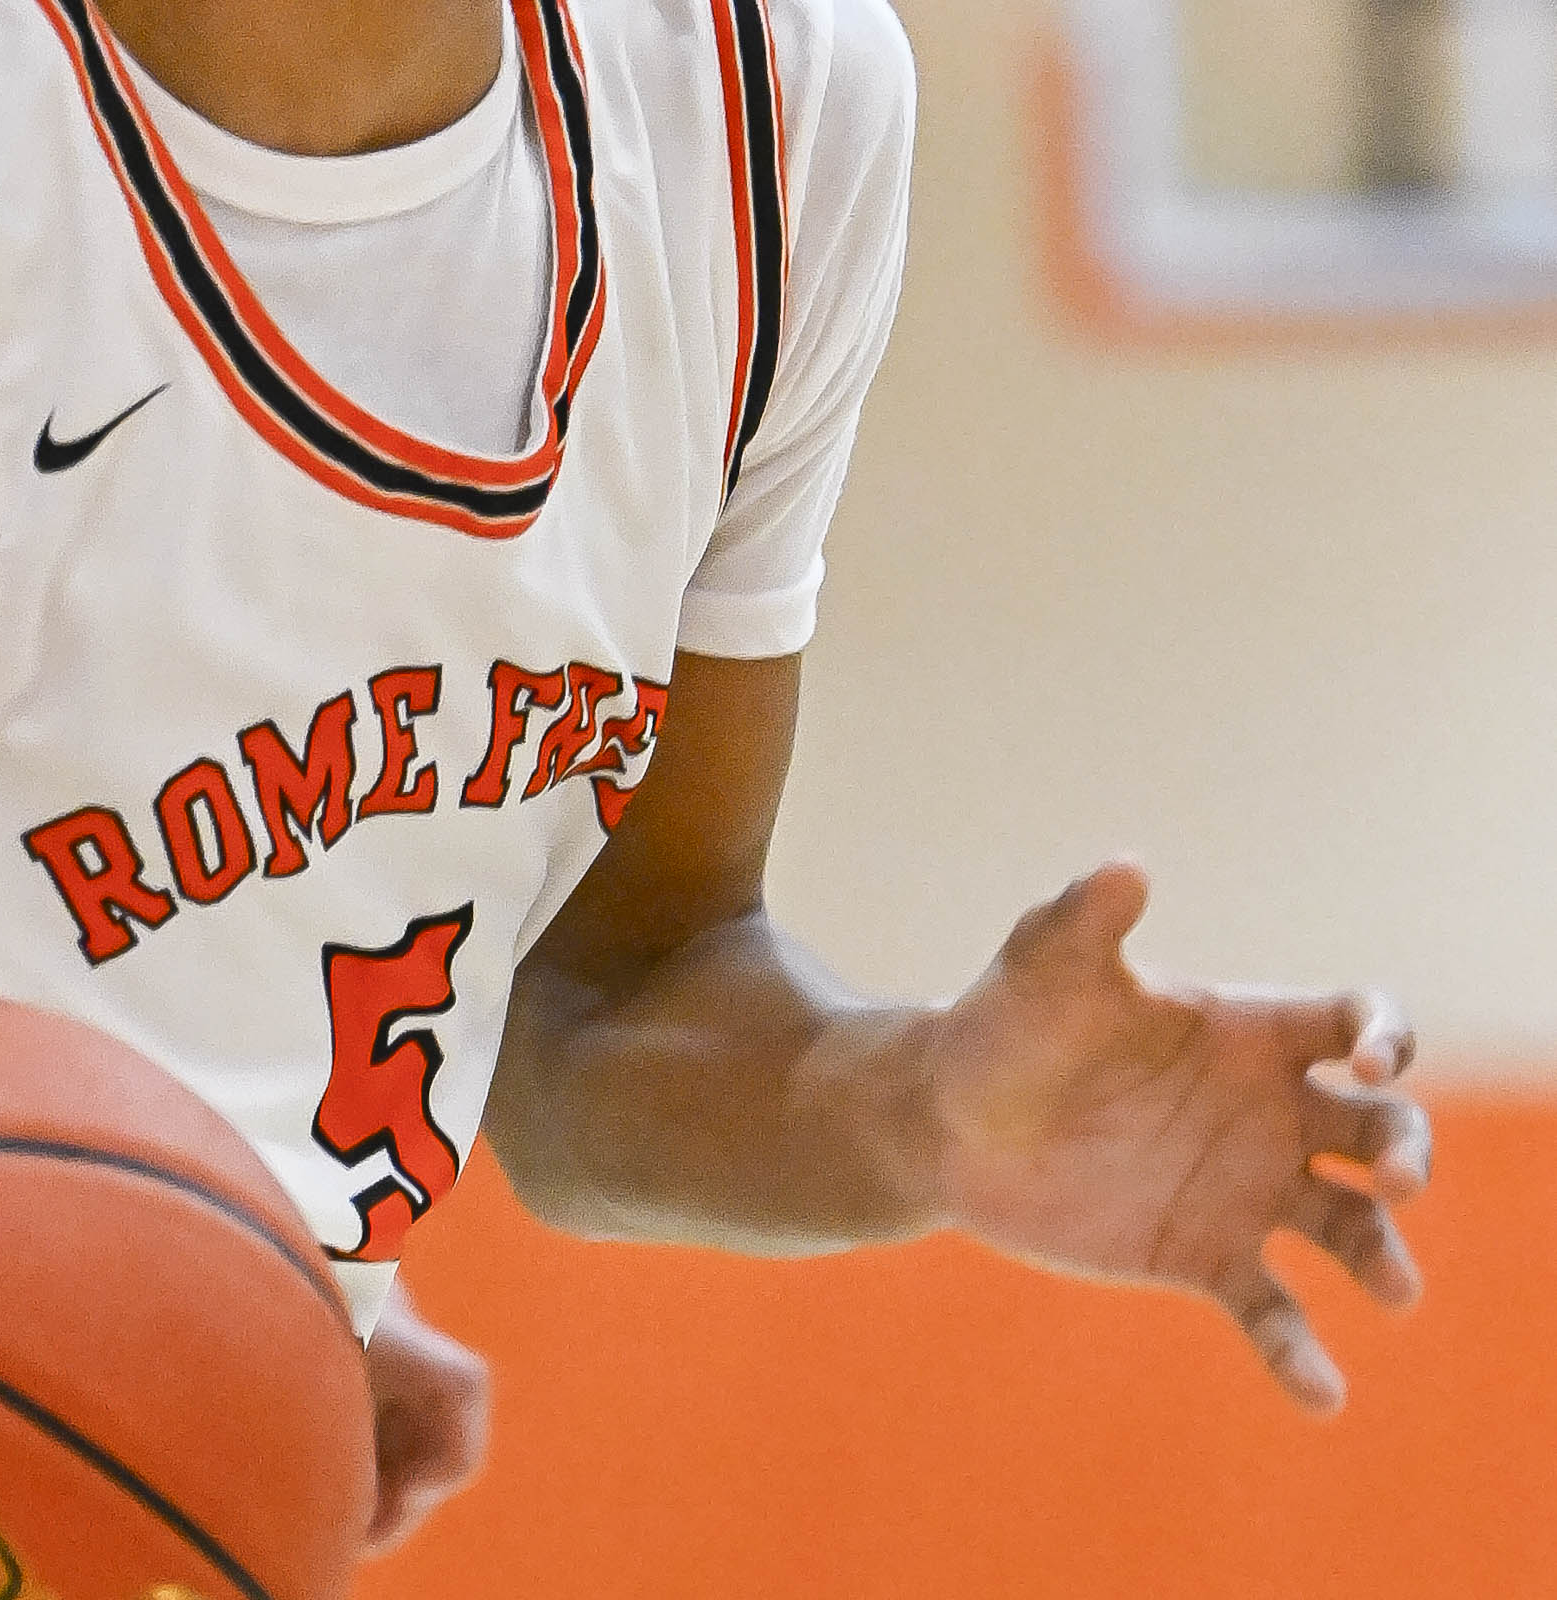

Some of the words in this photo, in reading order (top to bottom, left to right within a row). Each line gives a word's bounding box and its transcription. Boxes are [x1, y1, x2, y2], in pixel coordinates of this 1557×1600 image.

[20, 664, 443, 966] ROME
[458, 658, 670, 836] FRE
[311, 902, 474, 1262] 5
